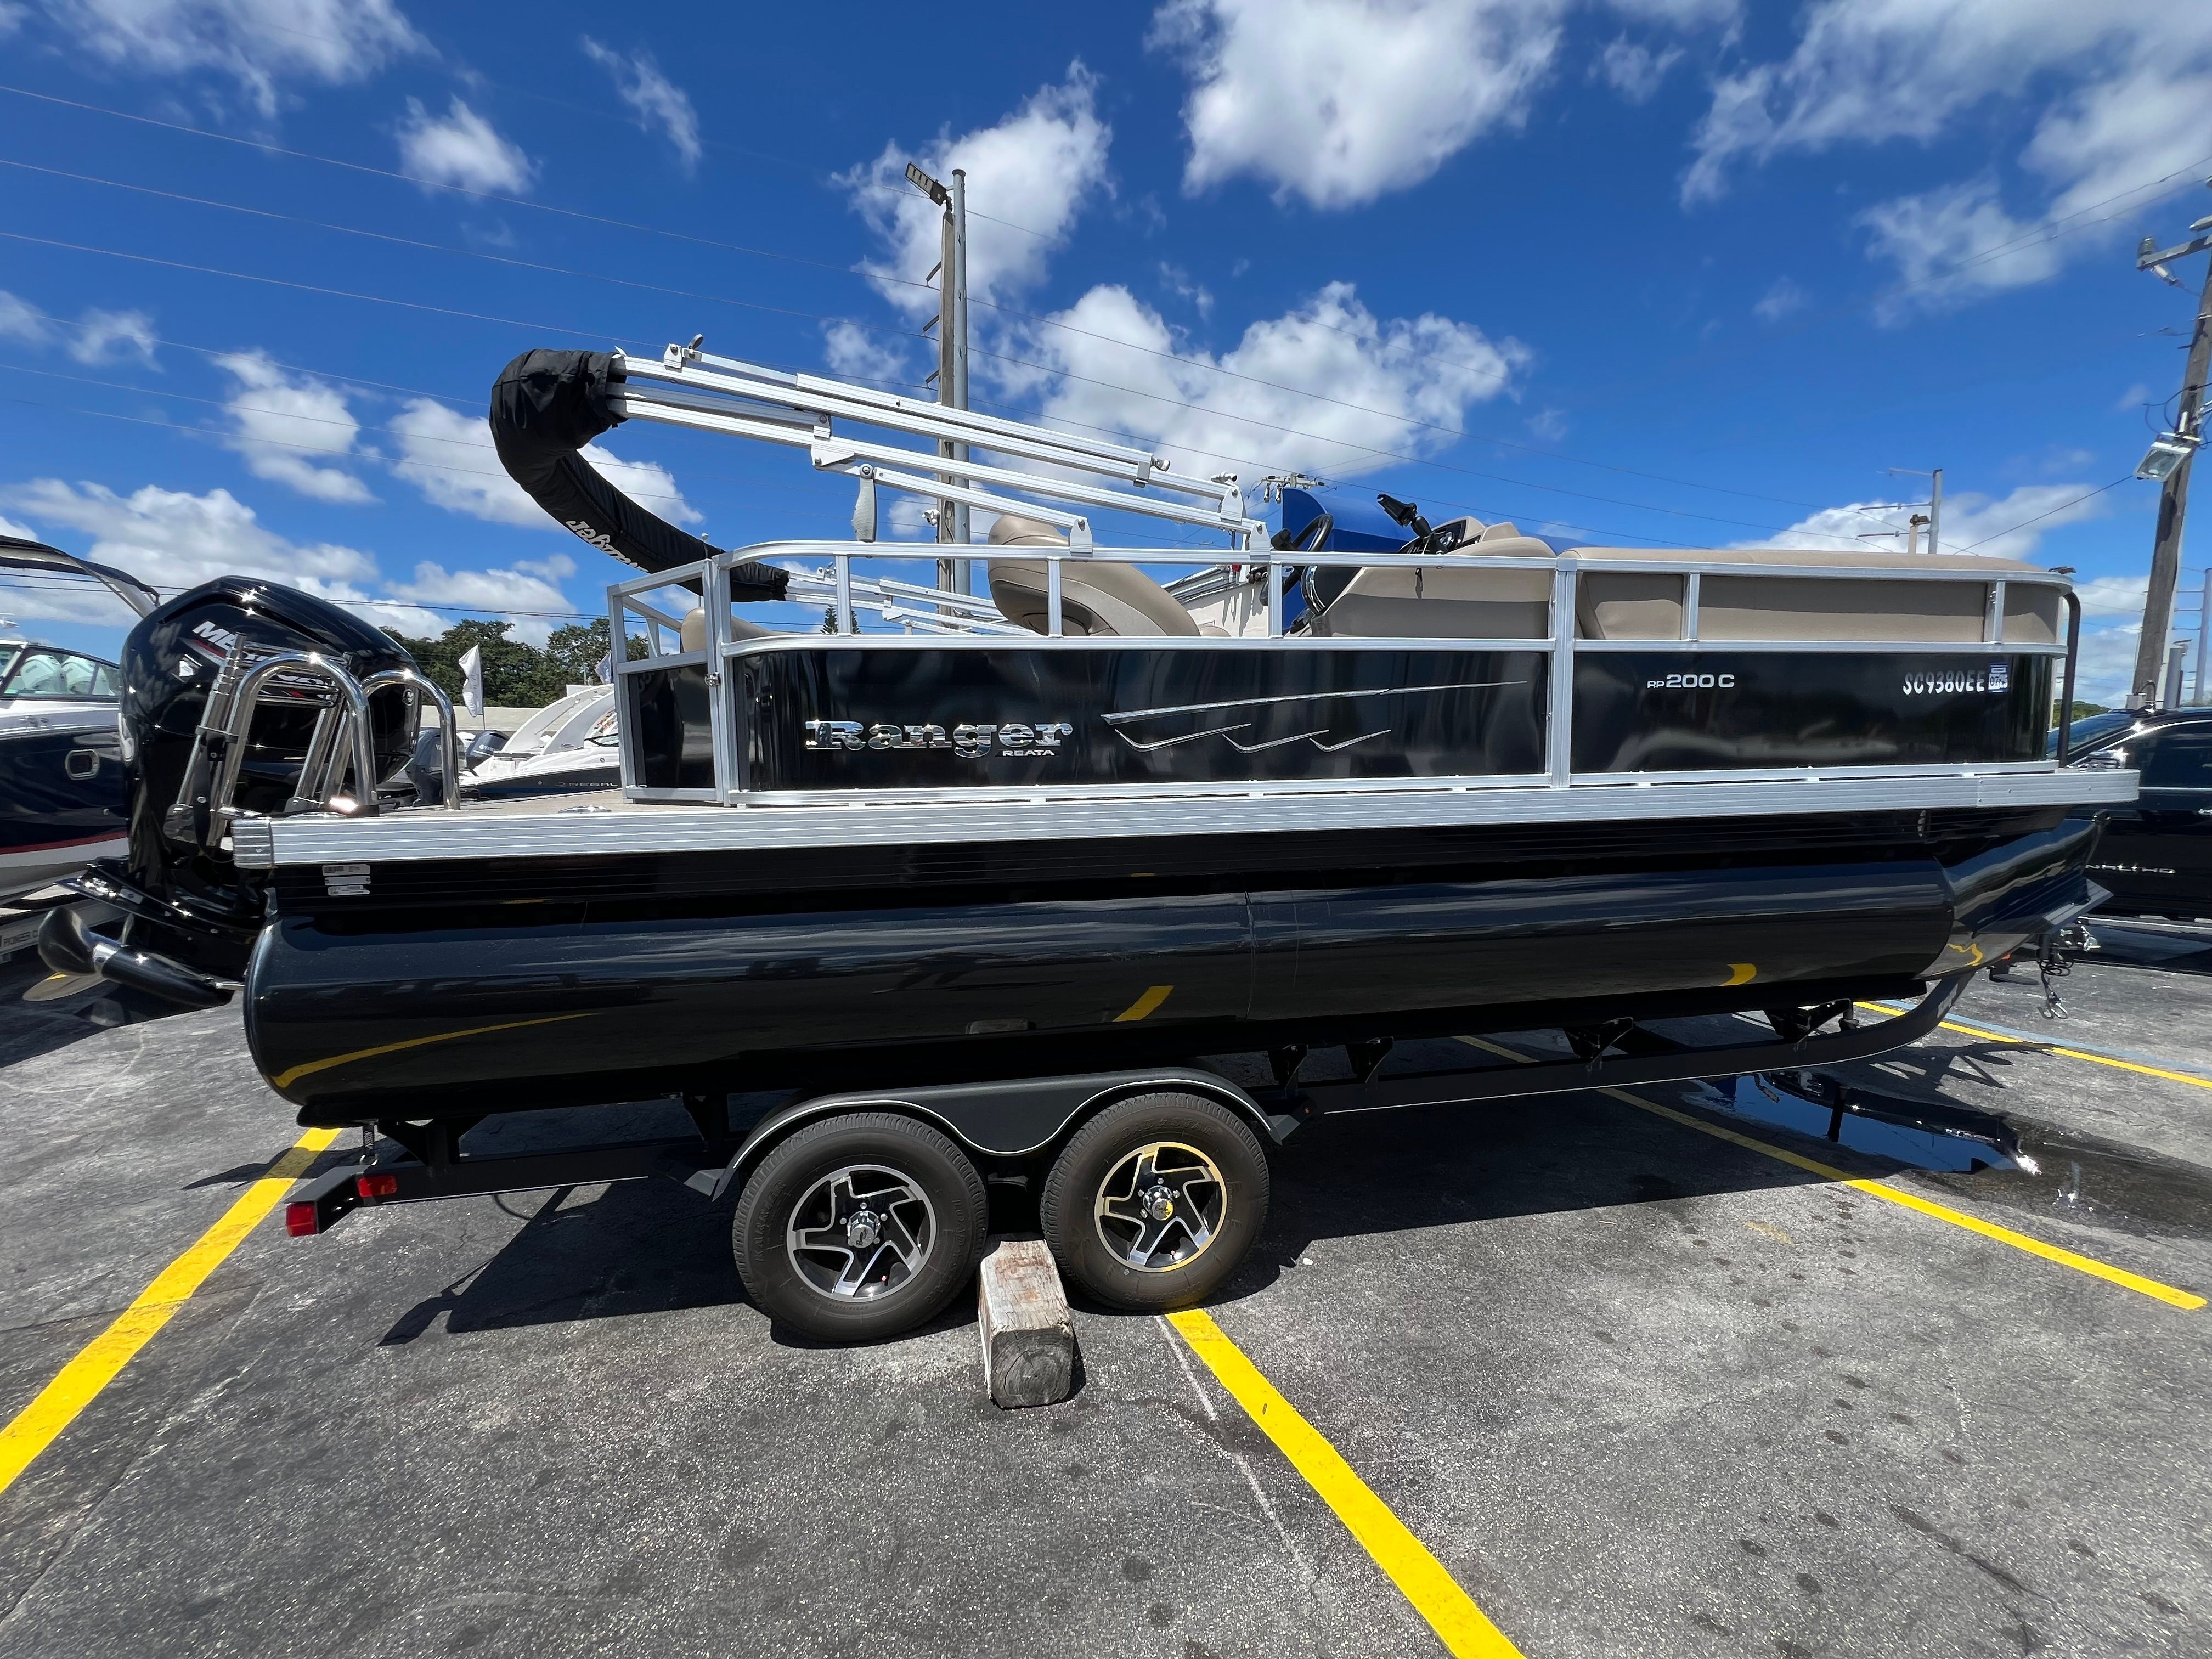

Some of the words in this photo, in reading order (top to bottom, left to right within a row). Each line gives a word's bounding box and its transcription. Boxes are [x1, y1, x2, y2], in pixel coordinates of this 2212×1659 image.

[566, 521, 649, 572] anger
[1903, 670, 1985, 695] SC9380EE
[805, 720, 1073, 758] Ranger
[754, 1180, 786, 1262] KARRIER
